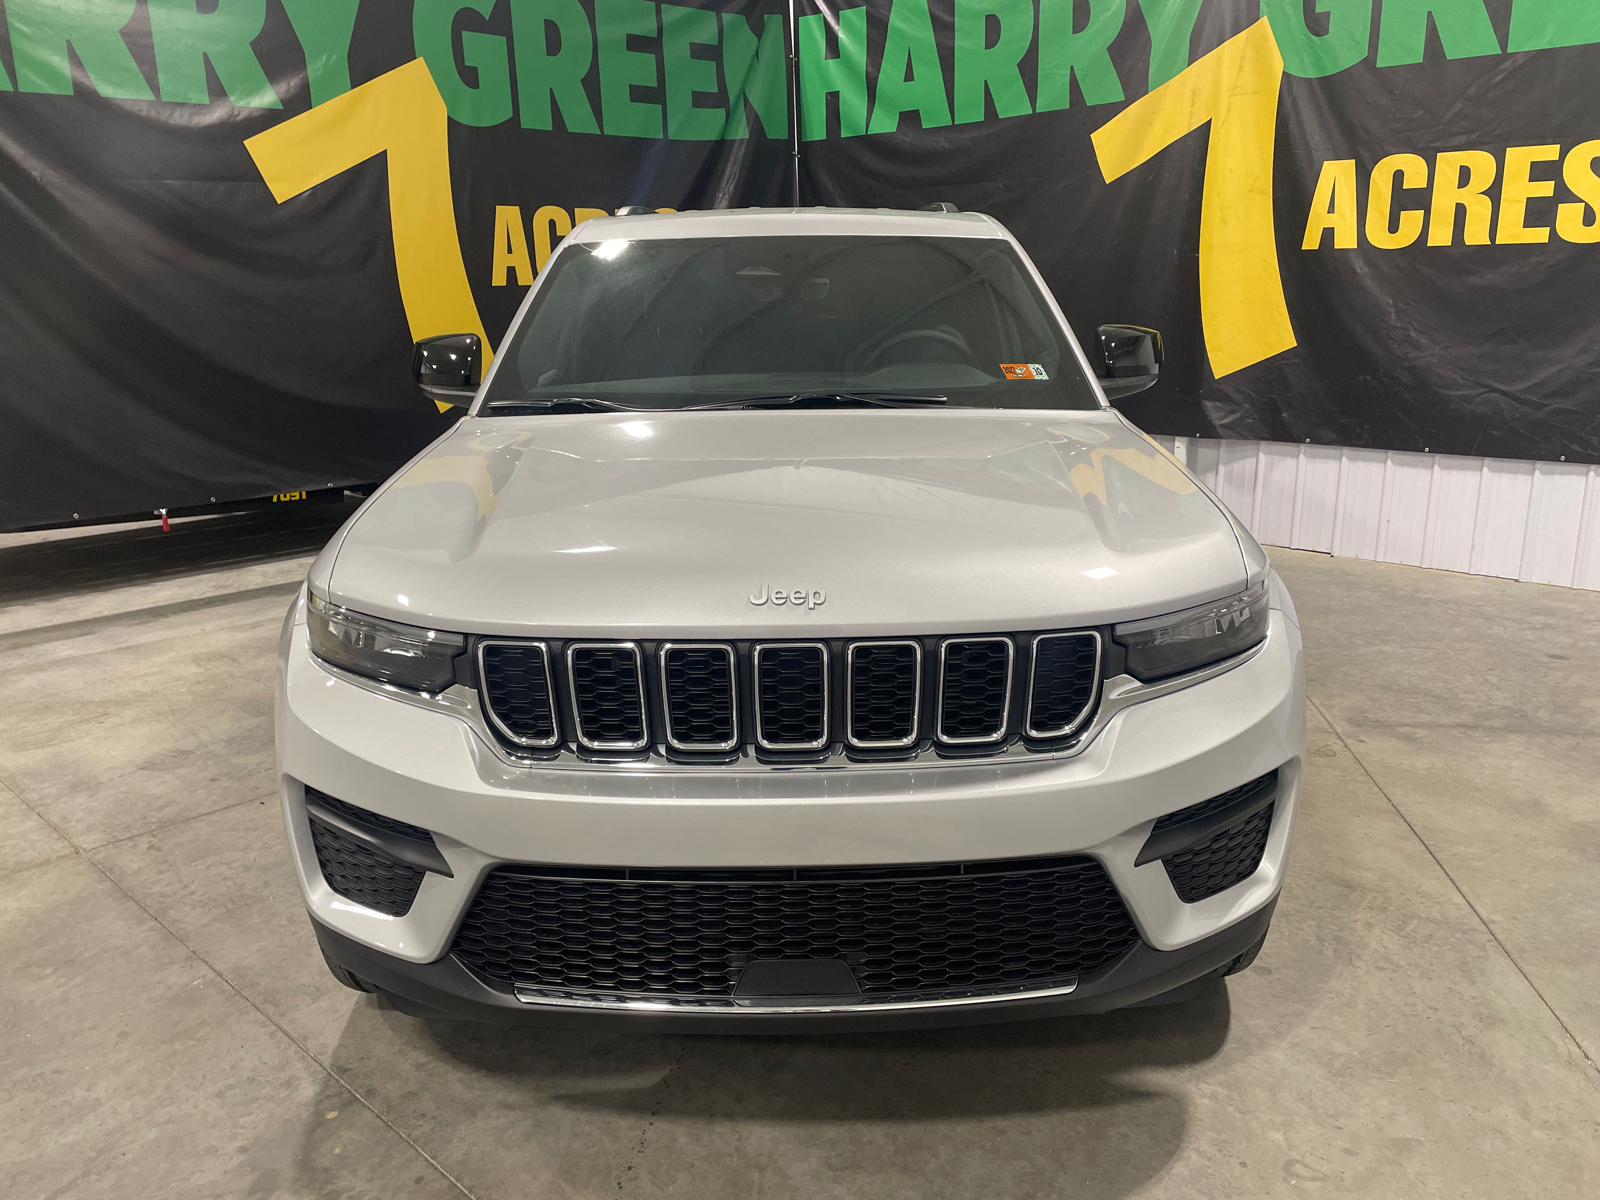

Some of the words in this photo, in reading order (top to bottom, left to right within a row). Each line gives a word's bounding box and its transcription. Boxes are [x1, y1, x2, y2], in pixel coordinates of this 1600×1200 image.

[0, 0, 360, 110] RRY
[412, 0, 789, 141] GREEN
[798, 0, 1200, 142] HARRY
[243, 56, 496, 414] 7
[1089, 15, 1297, 379] 7
[1301, 139, 1600, 250] ACRES
[749, 583, 827, 610] Jeep
